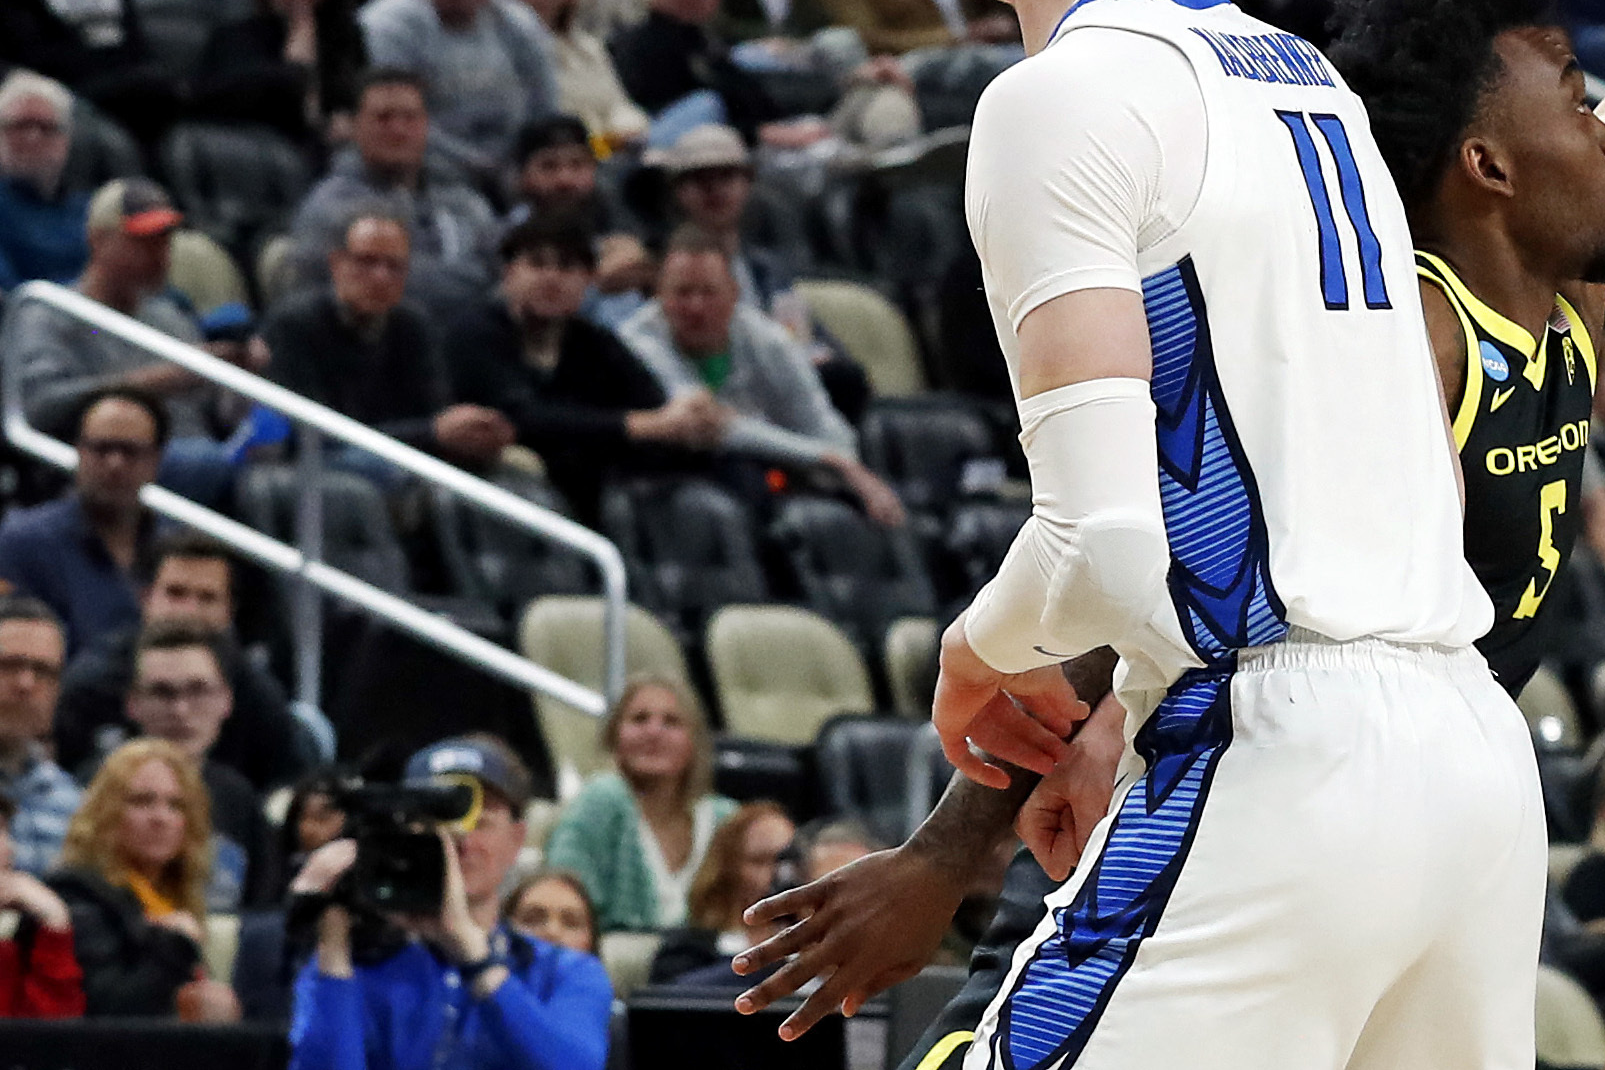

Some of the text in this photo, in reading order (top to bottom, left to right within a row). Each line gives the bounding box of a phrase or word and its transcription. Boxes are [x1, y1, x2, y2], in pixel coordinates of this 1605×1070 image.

[1272, 108, 1394, 311] 11
[1486, 420, 1589, 475] OREON
[1512, 479, 1567, 620] 5
